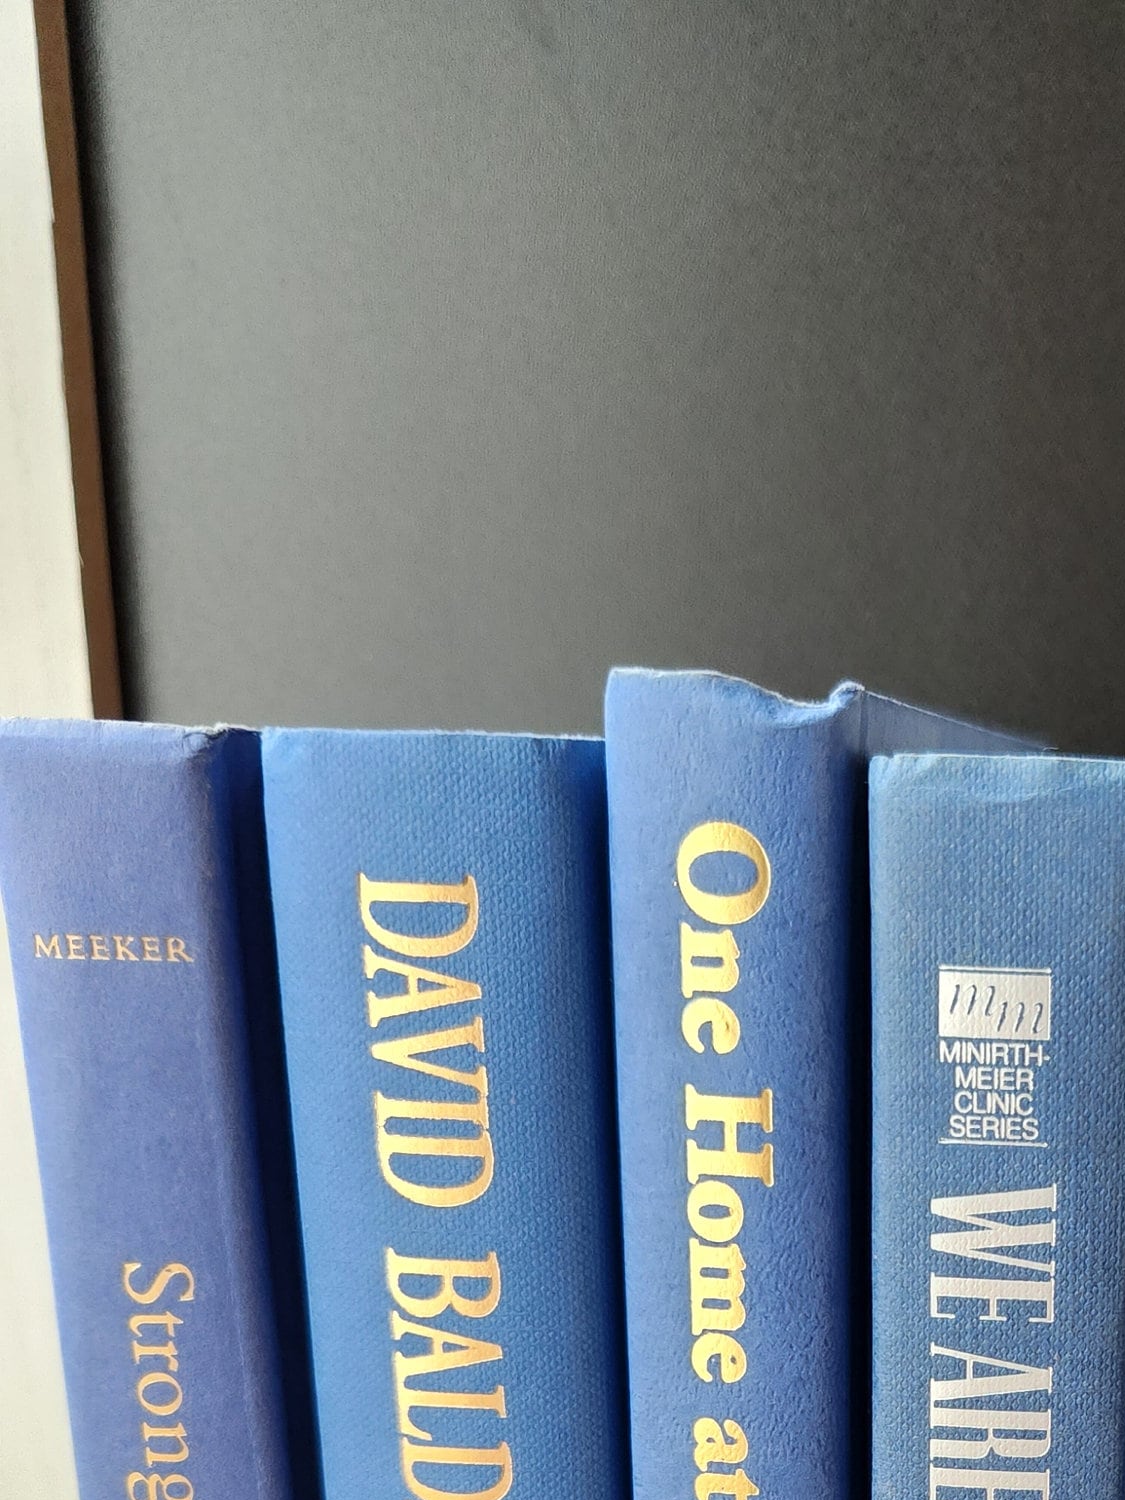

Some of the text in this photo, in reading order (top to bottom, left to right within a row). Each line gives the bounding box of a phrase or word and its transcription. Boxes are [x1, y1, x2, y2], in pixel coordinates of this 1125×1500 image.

[34, 933, 194, 964] MEEKER
[675, 822, 772, 1055] One
[358, 873, 495, 1208] DAVID
[939, 1041, 1051, 1066] MINIRTH-
[955, 1067, 1034, 1090] MEIER
[954, 1091, 1034, 1115] CLINIC
[949, 1115, 1039, 1140] SERIES
[682, 1083, 774, 1385] Home
[928, 1184, 1059, 1324] WE
